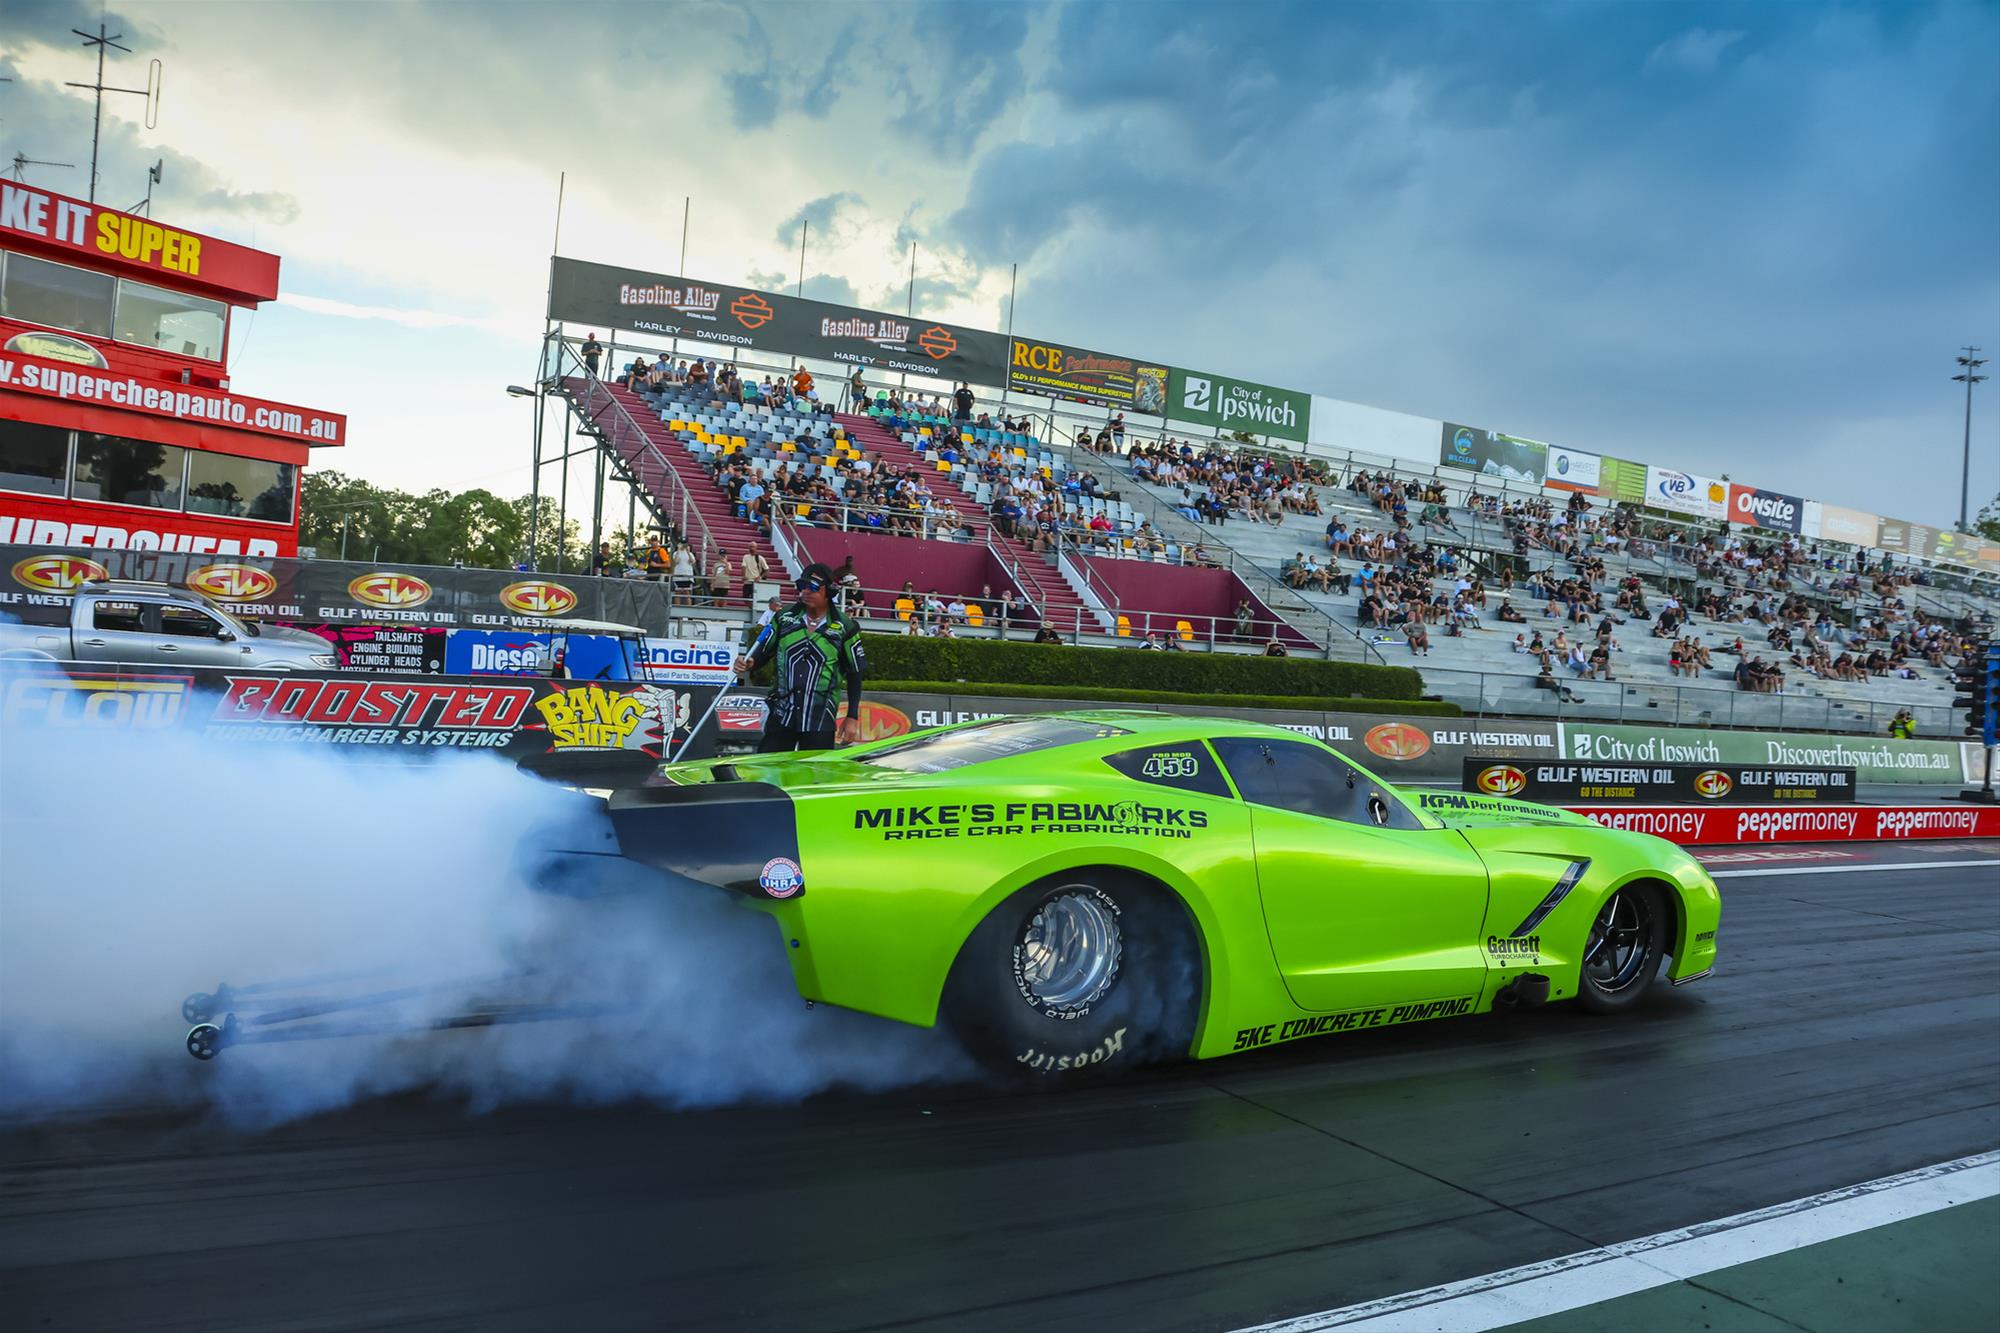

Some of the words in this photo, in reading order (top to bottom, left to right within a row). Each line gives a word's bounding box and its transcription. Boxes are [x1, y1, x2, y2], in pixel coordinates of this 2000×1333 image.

[55, 200, 92, 246] IT
[96, 212, 201, 275] SUPER
[620, 283, 681, 306] Gasoline
[686, 287, 720, 309] Alley
[634, 320, 681, 334] HARLEY
[696, 330, 753, 345] DAVIDSON
[821, 317, 875, 337] Gasoline
[878, 320, 910, 340] Alley
[833, 351, 876, 364] HARLEY
[888, 360, 939, 375] DAVIDSON
[1012, 342, 1063, 373] RCE
[1037, 376, 1080, 390] PERFORMANCE
[1080, 384, 1097, 393] PARTS
[1098, 387, 1134, 399] SUPERSTORE
[1232, 385, 1251, 400] City
[1252, 390, 1262, 400] of
[1217, 385, 1296, 427] Ipswich
[1669, 479, 1685, 492] WB
[278, 605, 303, 616] OIL
[319, 607, 357, 618] GULF
[361, 609, 430, 621] WESTERN
[433, 612, 457, 623] OIL
[472, 614, 508, 625] GULF
[353, 642, 383, 653] ENGINE
[386, 644, 423, 655] BUILDING
[375, 631, 423, 643] TAILSHAFTS
[350, 654, 389, 665] CYLINDER
[394, 656, 422, 667] HEADS
[633, 644, 731, 665] engine
[671, 671, 690, 680] Parts
[691, 672, 729, 681] Specialists
[211, 676, 534, 730] BOOSTED
[535, 687, 645, 731] BANG
[203, 724, 400, 746] TURBOCHARGER
[402, 730, 514, 747] SYSTEMS
[549, 723, 633, 749] SHIFT
[1328, 726, 1353, 740] OIL
[1433, 731, 1468, 744] GULF
[1470, 732, 1532, 747] WESTERN
[1534, 734, 1555, 747] OIL
[1595, 735, 1633, 760] City
[1637, 737, 1656, 760] of
[1660, 737, 1720, 762] Ipswich
[1766, 740, 1950, 769] DiscoverIpswich.com.au
[1142, 757, 1199, 778] 459
[1537, 767, 1578, 783] GULF
[1580, 768, 1649, 784] WESTERN
[1652, 769, 1676, 784] OIL
[1740, 771, 1773, 785] GULF
[1774, 772, 1828, 786] WESTERN
[1830, 773, 1848, 786] OIL
[1580, 787, 1590, 797] GO
[1591, 787, 1604, 797] THE
[1605, 787, 1636, 797] DISTANCE
[854, 804, 996, 829] MIKE'S
[1419, 794, 1470, 809] KPM
[1470, 800, 1561, 818] Performance
[884, 828, 959, 841] RACE
[967, 824, 1024, 836] CAR
[1031, 824, 1192, 839] FABRICATION
[1737, 811, 1858, 841] peppermoney
[1876, 811, 1979, 838] peppermoney
[765, 878, 798, 889] IHRA
[1095, 890, 1122, 916] USA
[1487, 935, 1540, 953] Garrett
[1013, 945, 1040, 1007] RACING
[1045, 1007, 1089, 1020] WELD
[1233, 1024, 1276, 1050] SKE
[1279, 1008, 1387, 1040] CONCRETE
[1387, 997, 1473, 1024] PUMPING
